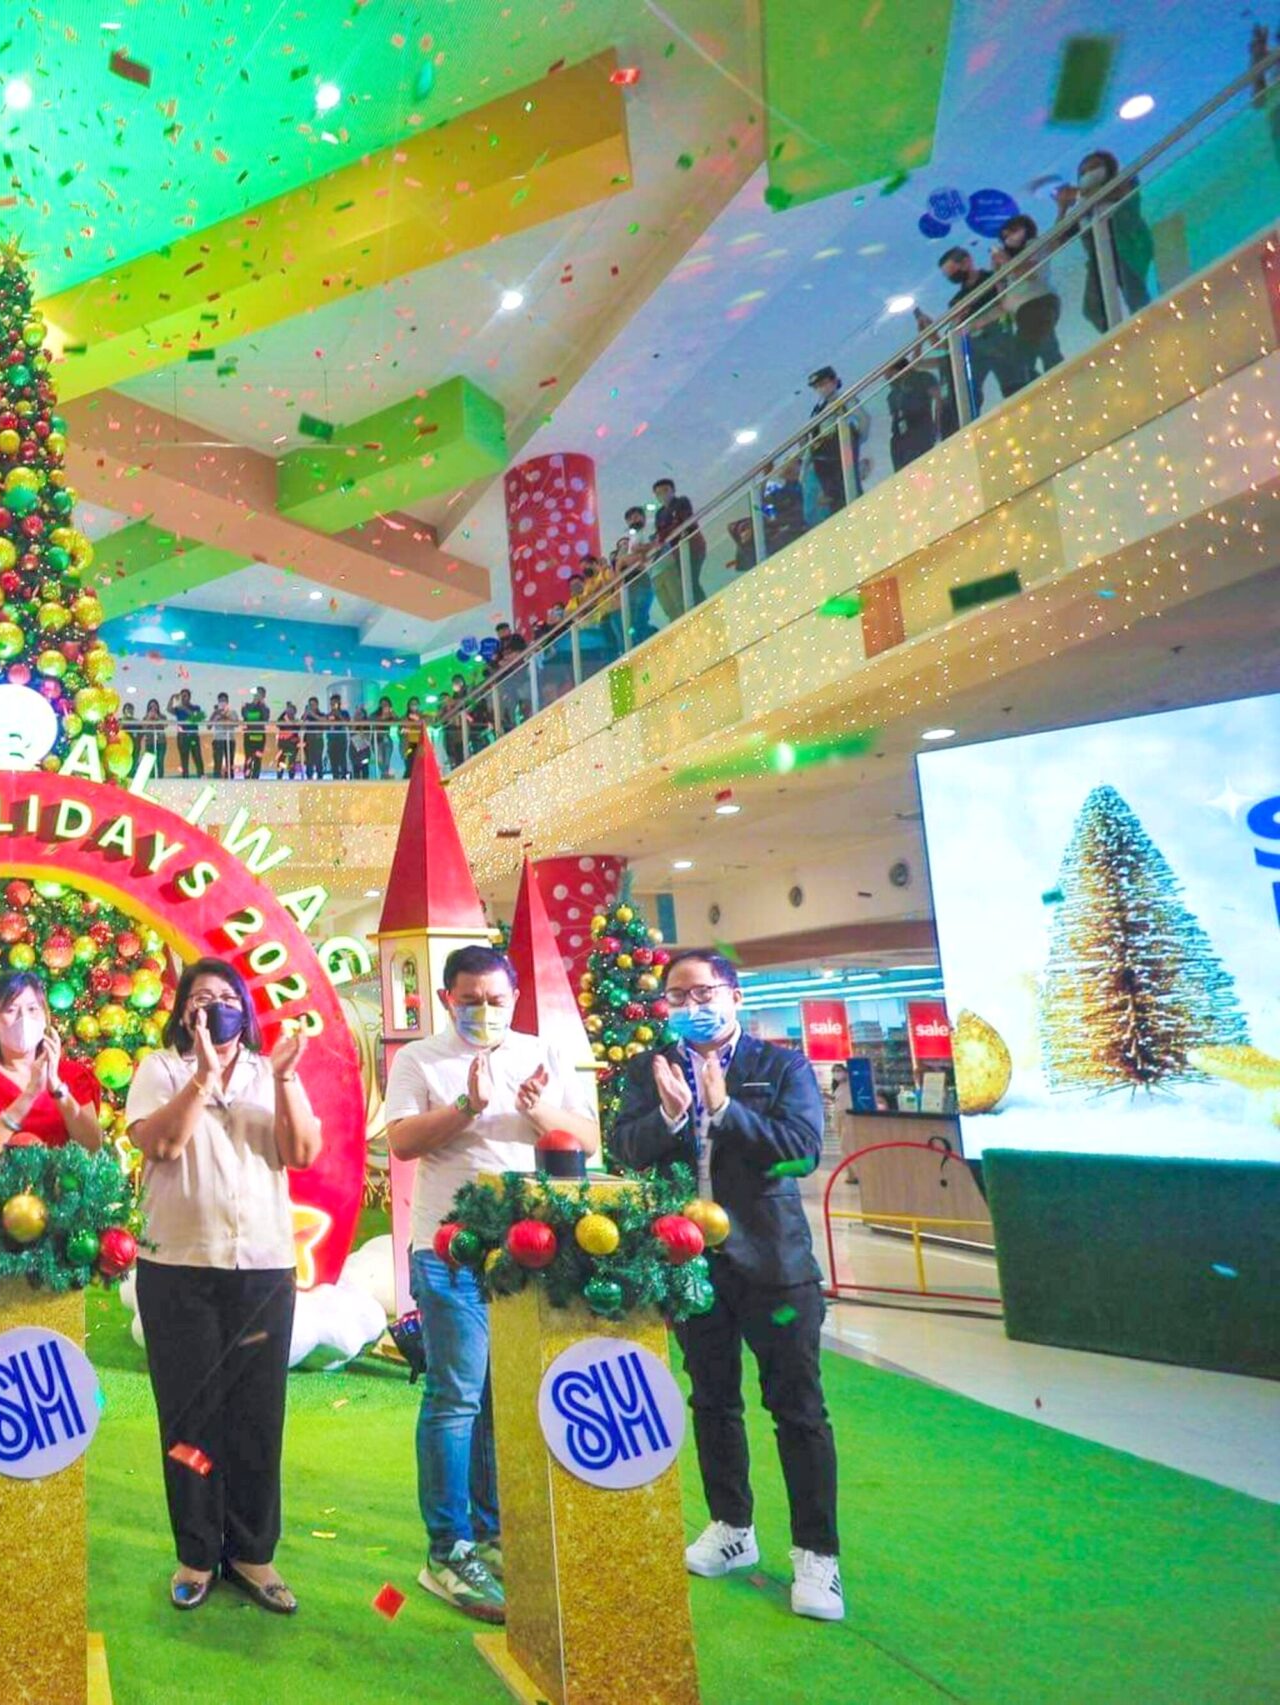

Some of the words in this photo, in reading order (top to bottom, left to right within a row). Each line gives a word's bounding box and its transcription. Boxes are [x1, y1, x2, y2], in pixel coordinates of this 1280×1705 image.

[222, 906, 324, 1038] 2022
[809, 1018, 843, 1036] sale
[915, 1019, 950, 1037] sale
[551, 1352, 672, 1471] SM
